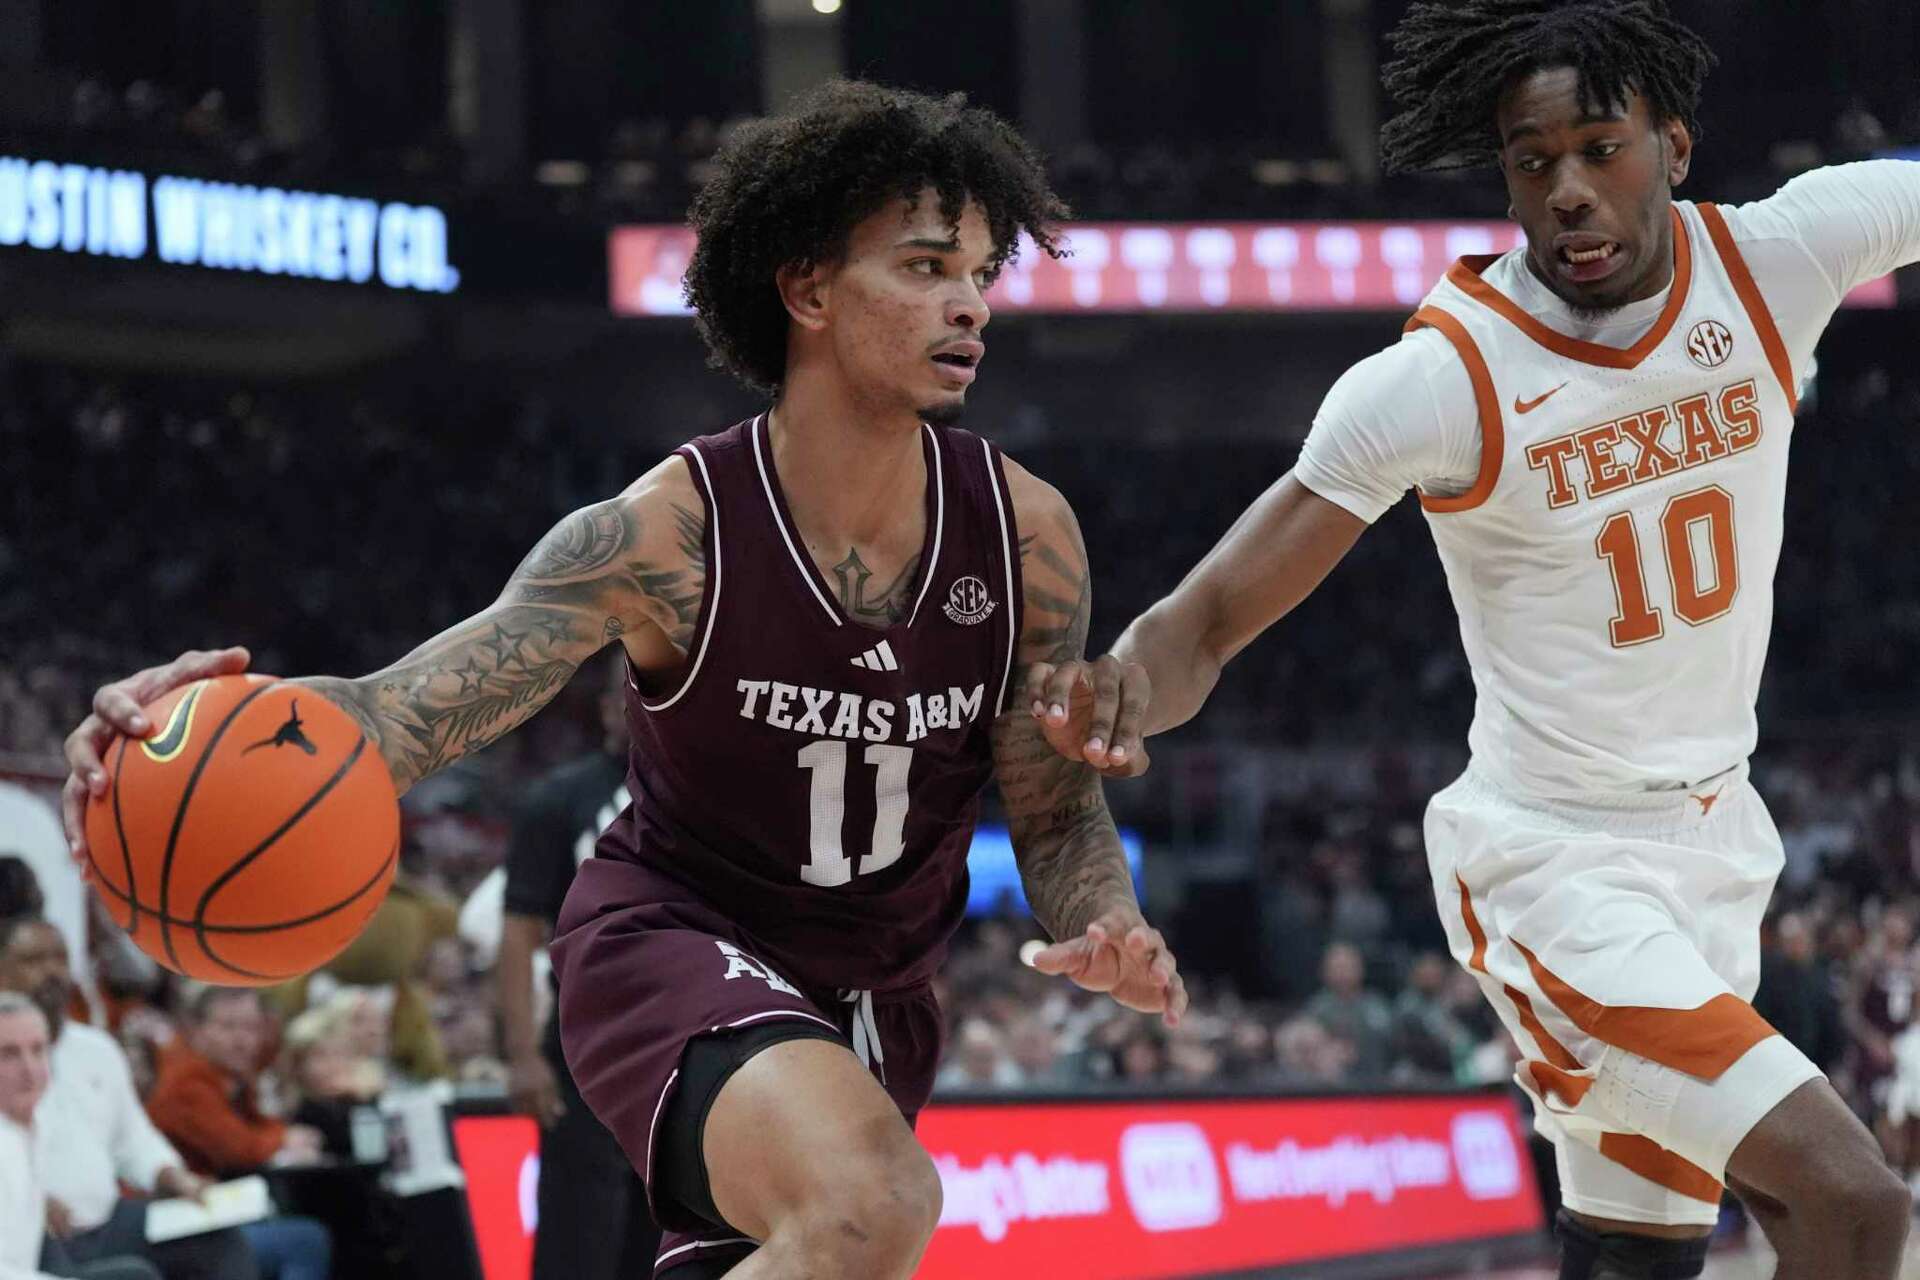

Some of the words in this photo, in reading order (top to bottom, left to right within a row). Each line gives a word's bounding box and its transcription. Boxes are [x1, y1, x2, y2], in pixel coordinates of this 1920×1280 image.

[1688, 320, 1732, 367] SEC
[1525, 378, 1763, 510] TEXAS
[950, 576, 987, 614] SEC
[1595, 484, 1740, 648] 10
[736, 678, 895, 742] TEXAS
[906, 683, 985, 742] A&M
[798, 740, 914, 887] 11
